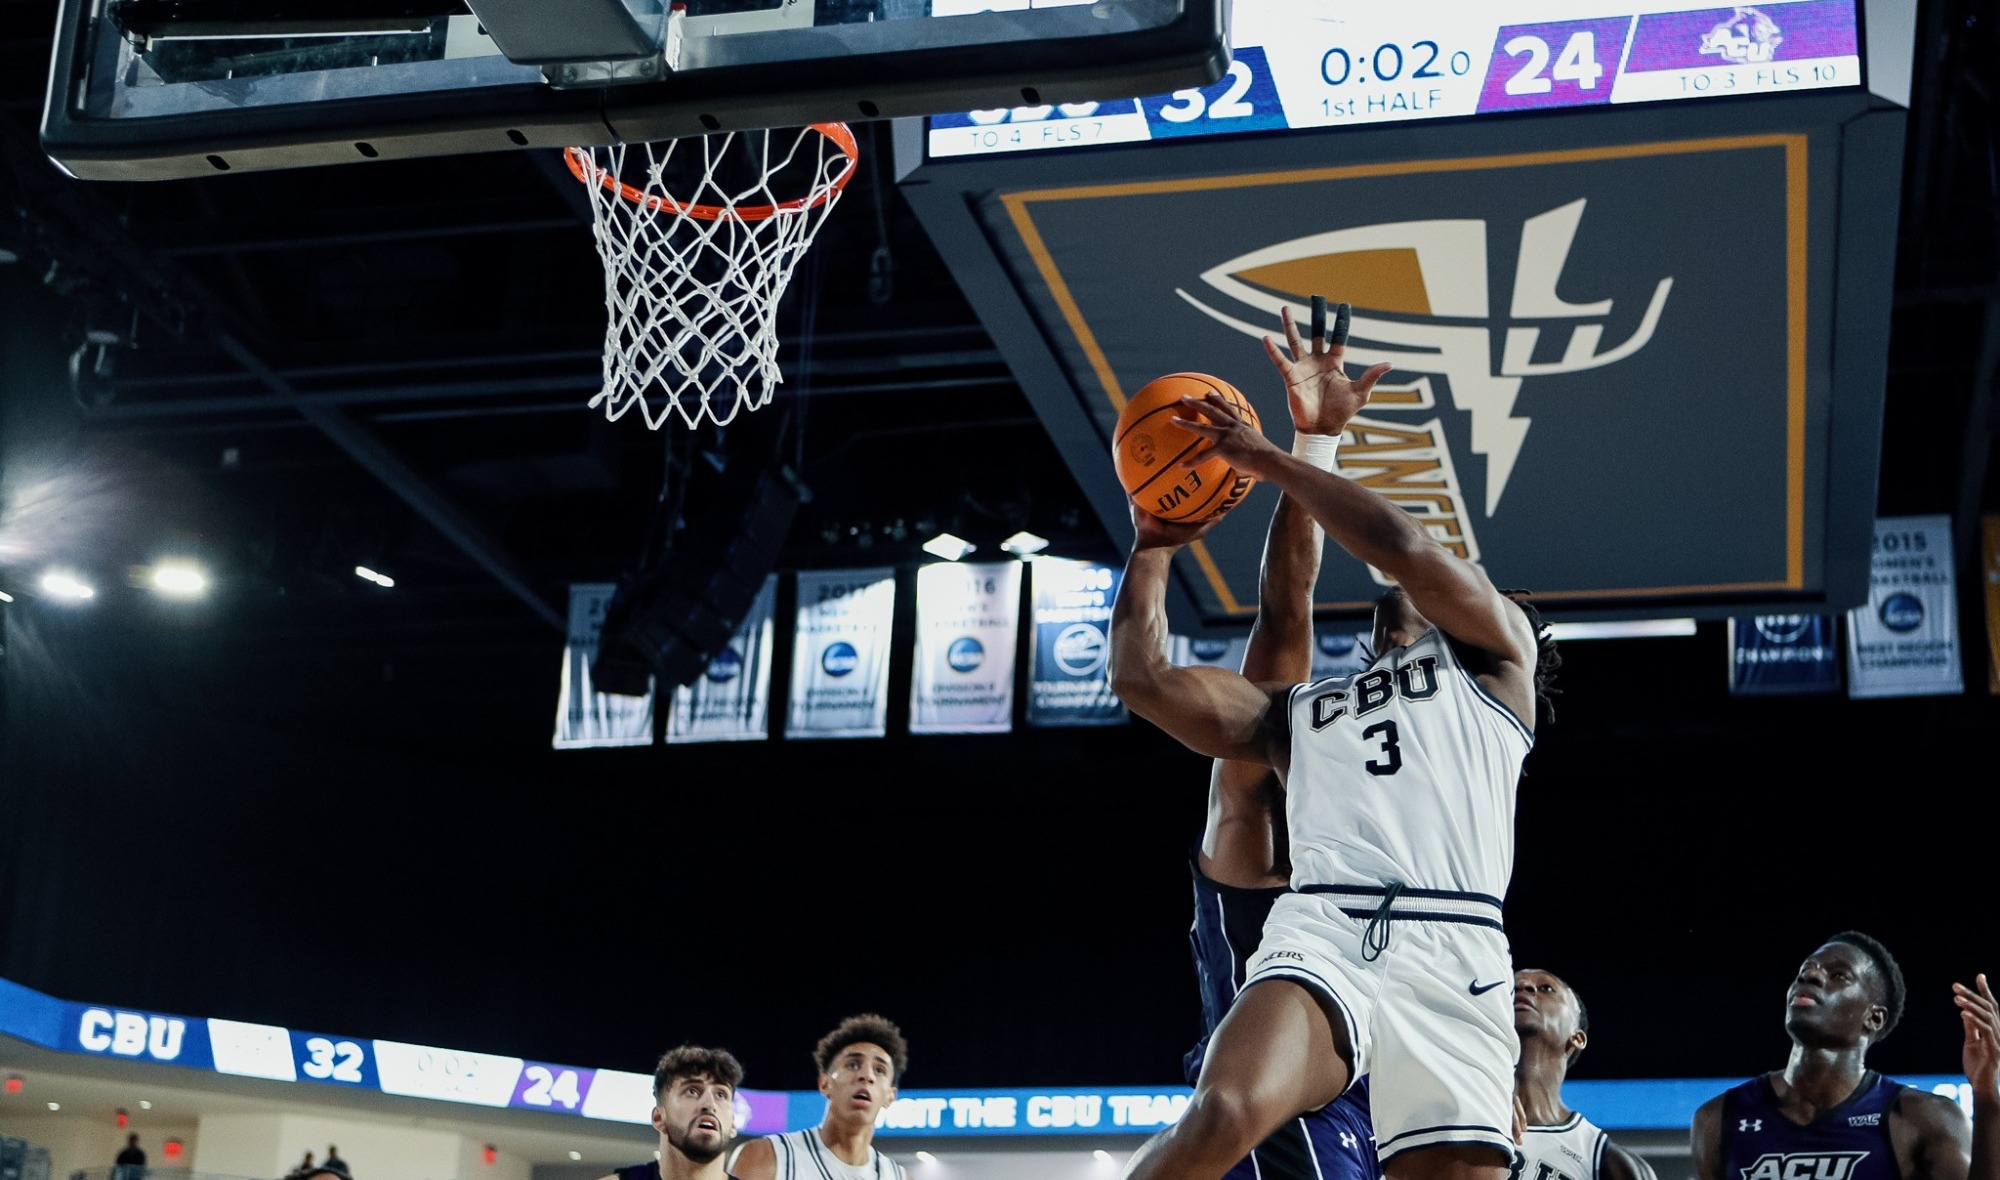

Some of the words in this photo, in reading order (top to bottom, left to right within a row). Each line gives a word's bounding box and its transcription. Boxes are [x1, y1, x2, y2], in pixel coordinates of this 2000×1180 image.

[1503, 31, 1603, 95] 24
[1680, 74, 1711, 92] TO
[1723, 72, 1736, 89] 3
[1756, 67, 1800, 86] FLS
[1813, 64, 1837, 82] 10
[1321, 98, 1356, 118] 1st
[1366, 89, 1443, 114] HALF
[970, 130, 999, 148] TO
[1010, 129, 1022, 144] 4
[1043, 124, 1082, 143] FLS
[1092, 122, 1103, 139] 7
[1157, 470, 1203, 512] EVO
[1309, 654, 1441, 733] CBU
[1362, 719, 1402, 776] 3
[80, 1007, 185, 1060] CBU
[302, 1037, 364, 1083] 32
[523, 1066, 581, 1109] 24
[950, 1097, 1017, 1128] THE
[1027, 1095, 1101, 1127] CBU
[1848, 1113, 1882, 1127] WAC
[1740, 1150, 1871, 1180] ACU
